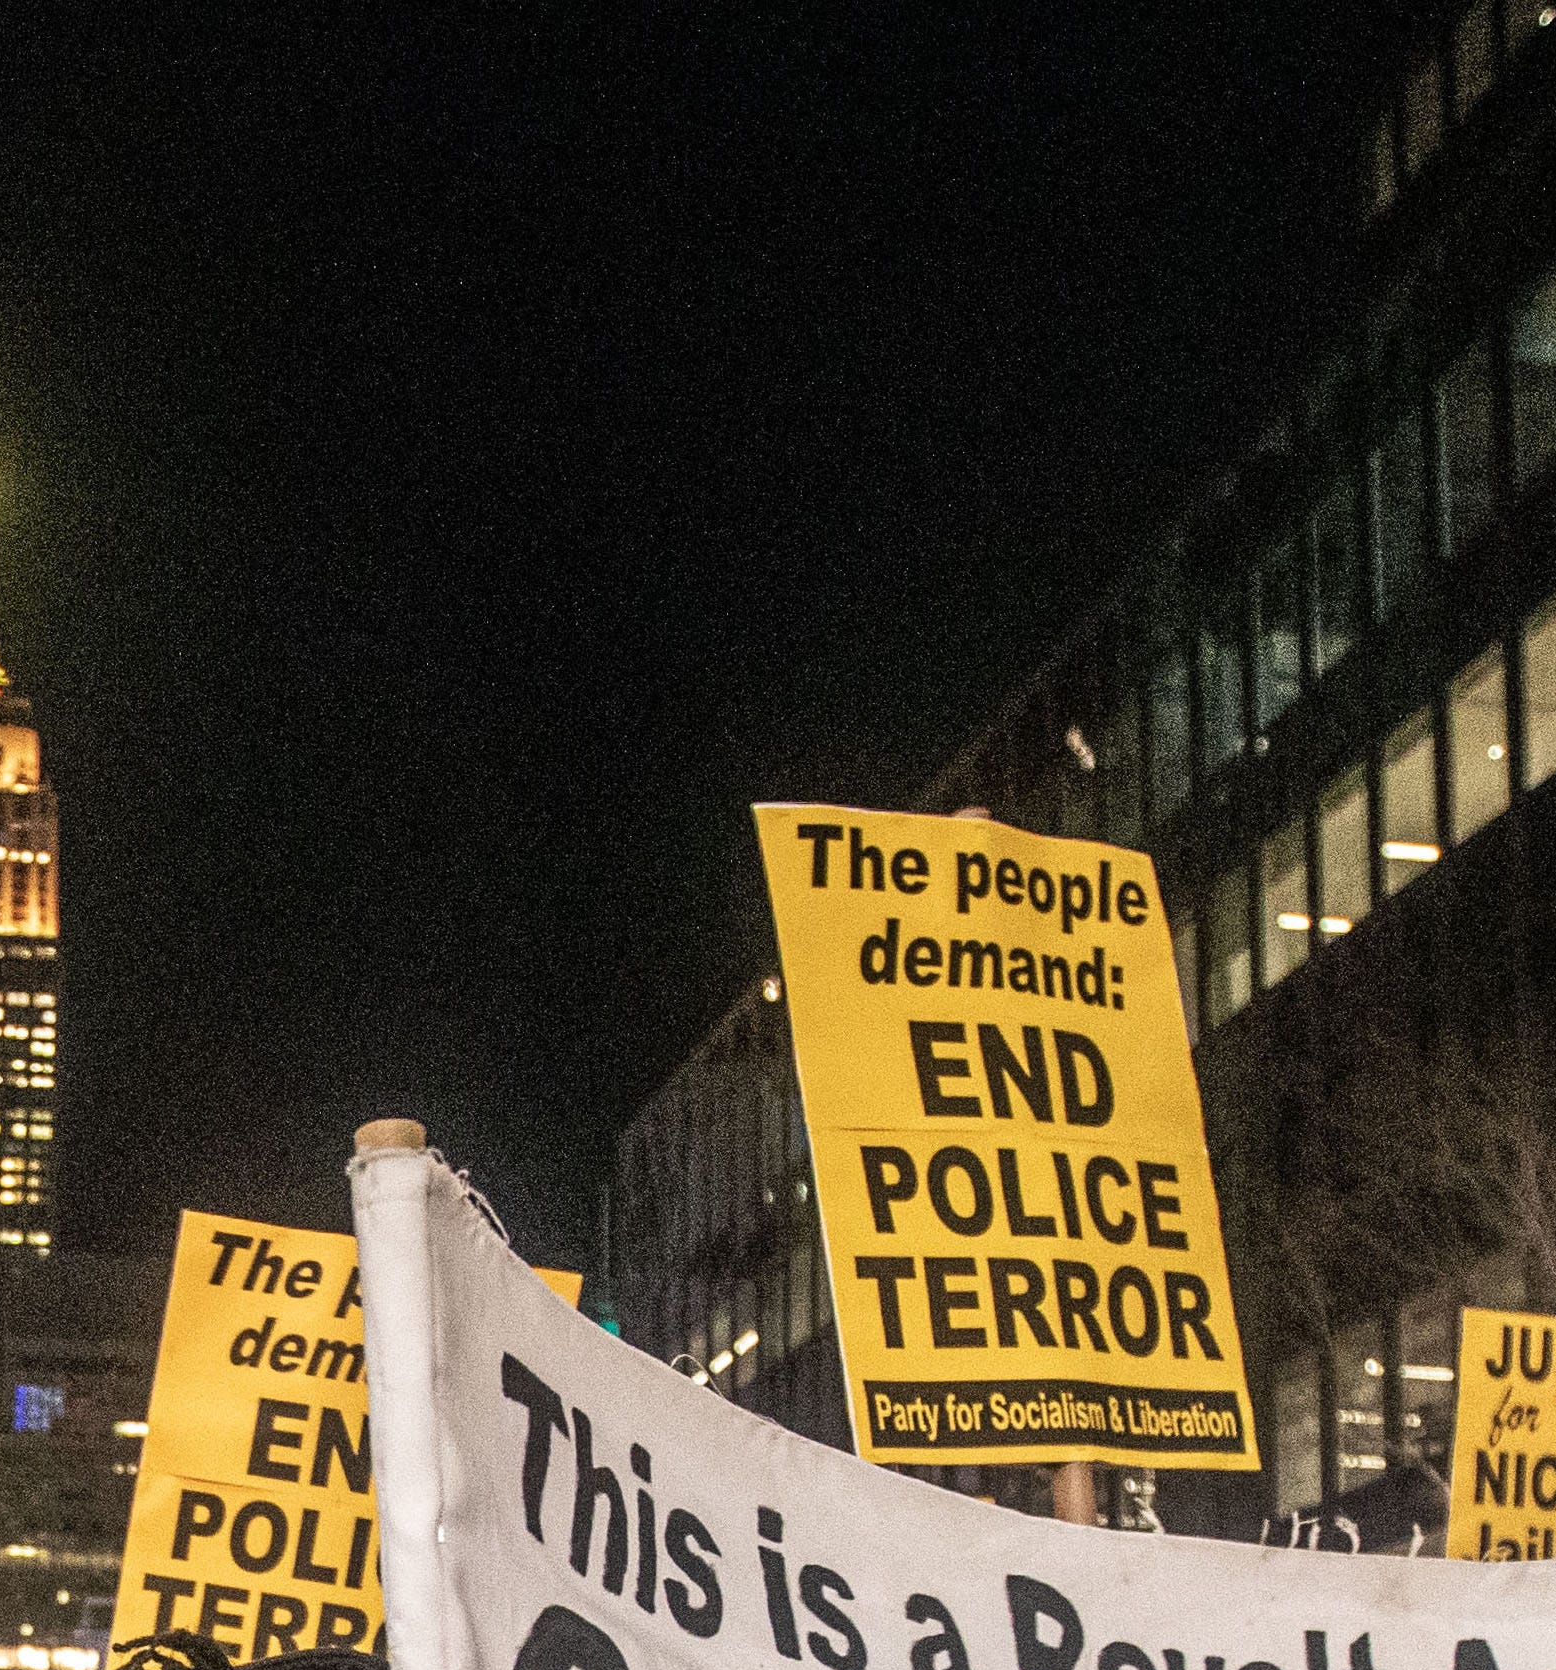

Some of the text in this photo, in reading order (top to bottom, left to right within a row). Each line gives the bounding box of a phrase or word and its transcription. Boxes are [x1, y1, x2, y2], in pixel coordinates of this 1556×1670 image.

[797, 823, 1150, 935] The people
[861, 918, 1125, 1010] demand:
[908, 1019, 1116, 1128] END
[860, 1144, 1190, 1252] POLICE
[209, 1231, 322, 1298] The
[855, 1255, 1225, 1362] TERROR
[247, 1397, 371, 1495] EN
[875, 1391, 1238, 1441] Party for Socialism & Liberation
[1489, 1386, 1541, 1447] for
[171, 1488, 381, 1590] POLI
[501, 1352, 724, 1639] This
[143, 1573, 387, 1662] TERR
